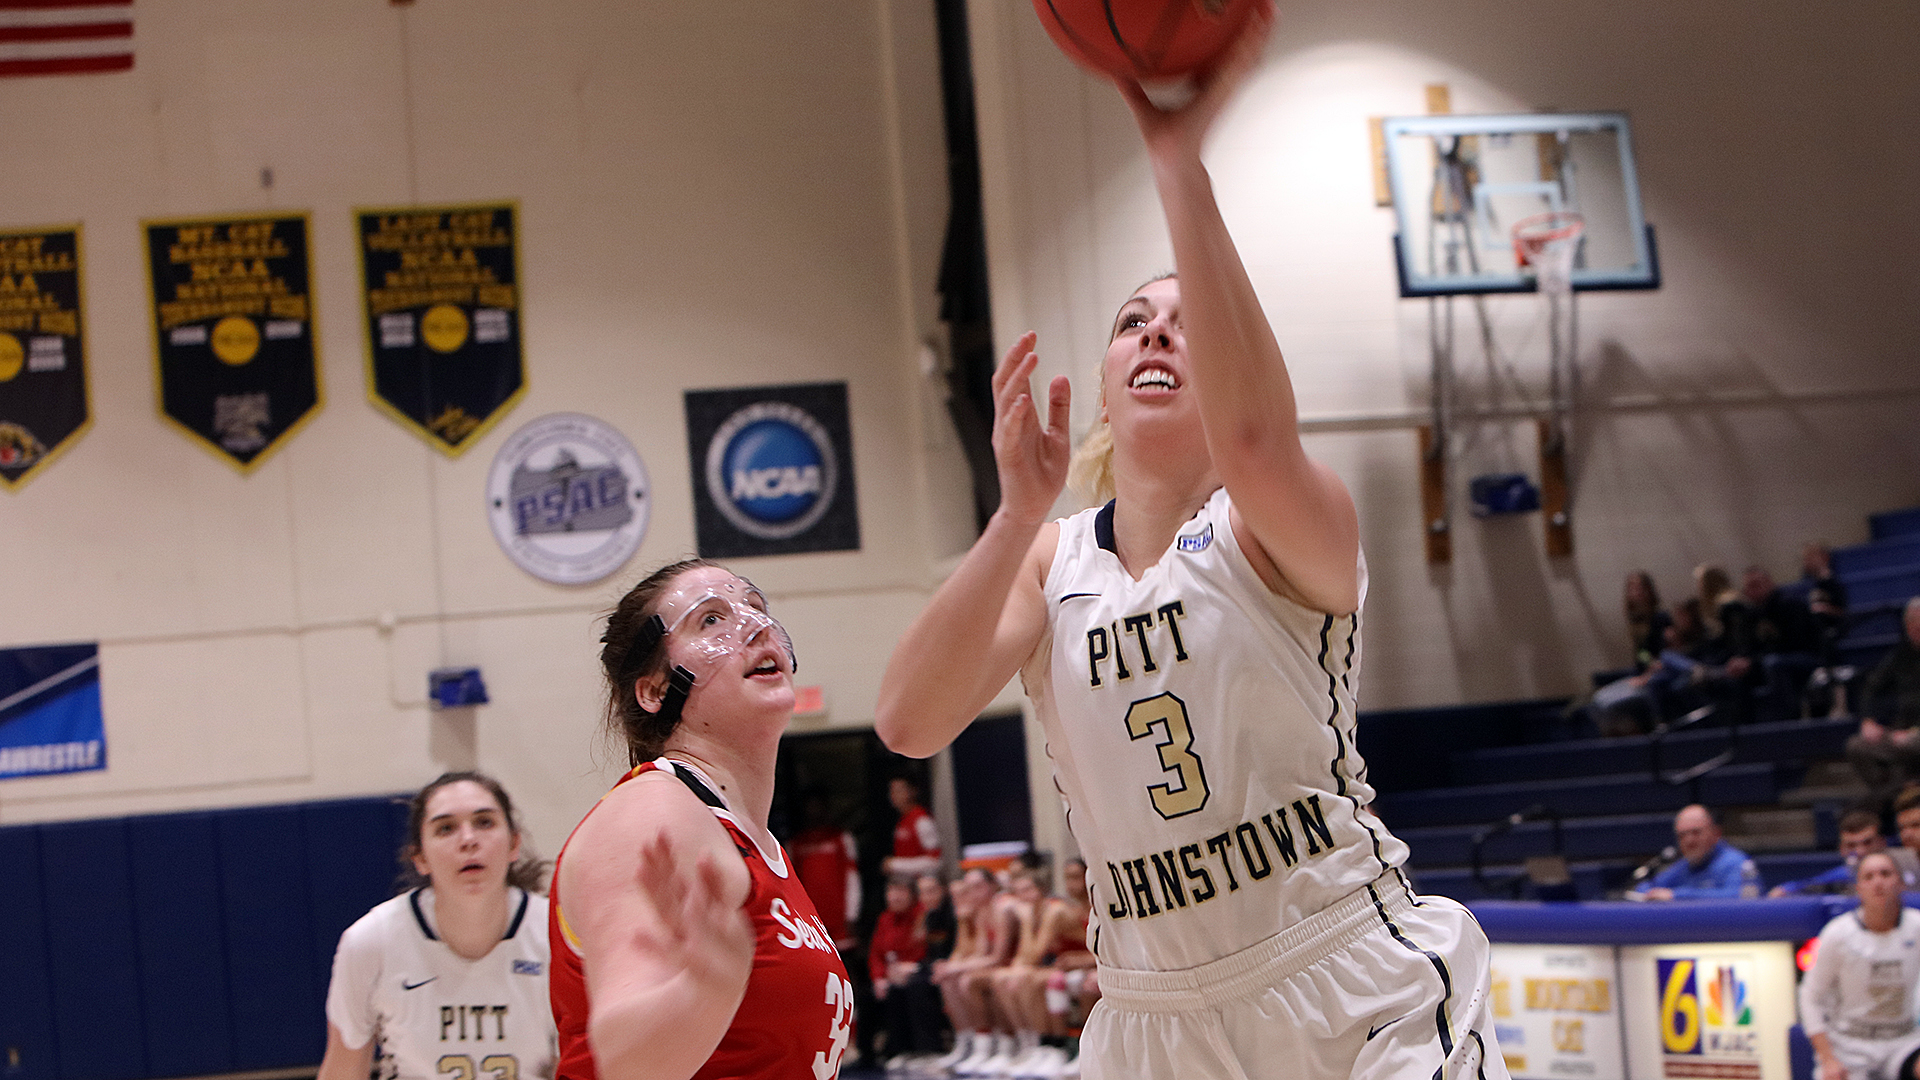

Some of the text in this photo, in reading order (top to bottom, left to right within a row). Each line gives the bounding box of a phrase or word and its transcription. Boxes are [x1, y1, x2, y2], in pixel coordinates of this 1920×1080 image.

[191, 258, 268, 280] NCAA
[400, 250, 477, 267] NCAA
[516, 468, 621, 533] PSAC
[732, 464, 820, 500] NCAA
[1088, 600, 1190, 688] PITT
[1124, 690, 1211, 821] 3
[440, 1004, 508, 1041] PITT
[1662, 958, 1699, 1053] 6
